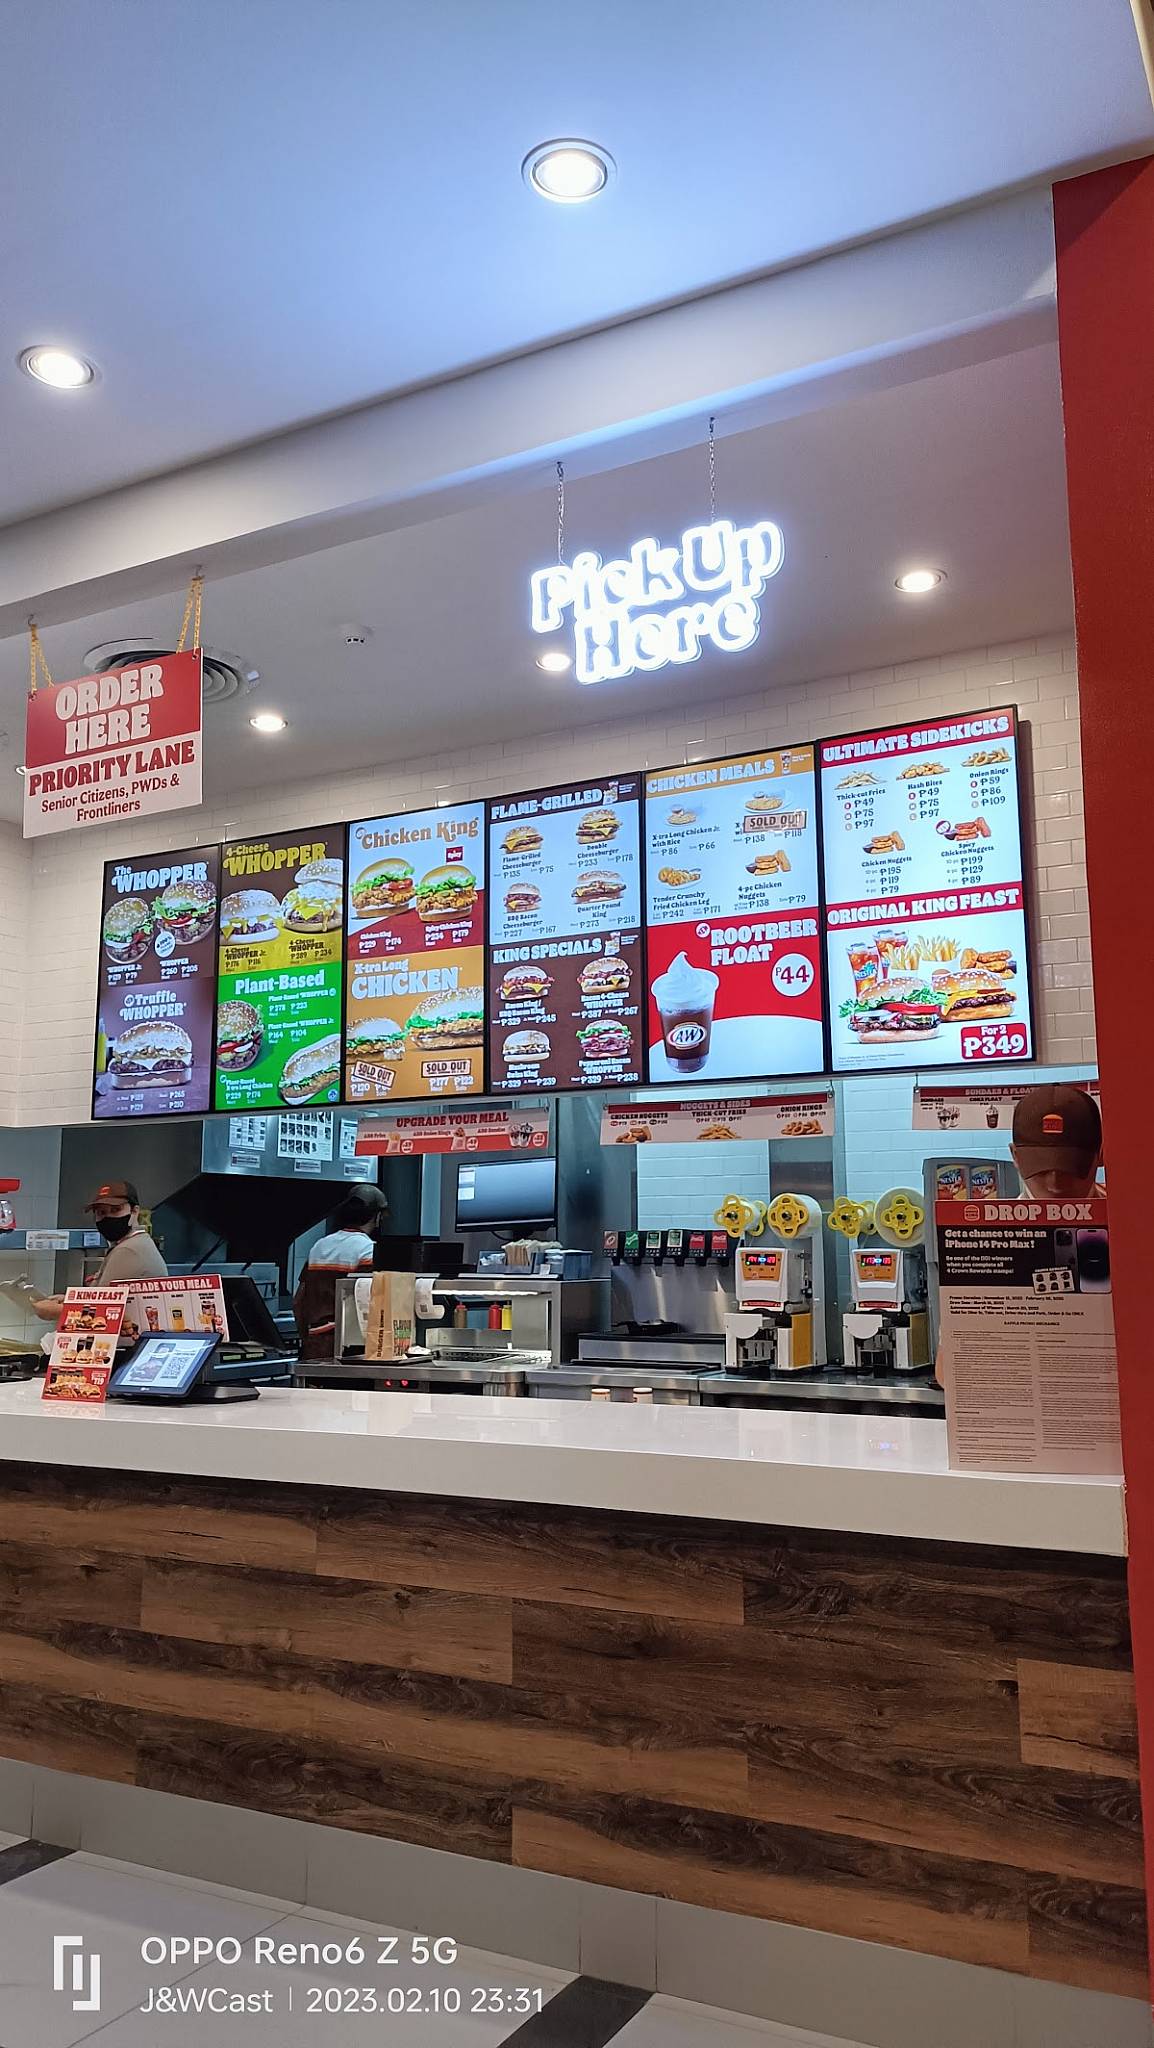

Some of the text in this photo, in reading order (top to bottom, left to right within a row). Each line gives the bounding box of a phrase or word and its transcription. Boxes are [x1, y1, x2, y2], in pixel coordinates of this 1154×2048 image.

[574, 591, 761, 685] Here
[55, 664, 164, 721] ORDER
[65, 703, 151, 755] HERE
[823, 716, 1009, 762] ULTIMATE SIDEKICKS
[29, 740, 195, 796] PRIORITY LANE
[969, 767, 1009, 779] Onion Rings
[646, 768, 718, 794] CHICKEN
[719, 758, 776, 781] MEALS
[907, 779, 943, 790] Hash Bites
[41, 773, 180, 813] Senior Citizens, PWDs &
[868, 788, 886, 797] Fries
[76, 800, 141, 822] Frontliners
[491, 788, 603, 820] FLAME-GRILLED
[749, 813, 802, 828] SOLD OUT
[355, 819, 480, 850] Chicken King
[668, 831, 685, 840] Long
[685, 827, 713, 837] Chicken
[226, 842, 270, 857] 4-Cheese
[652, 838, 681, 847] with Rice
[577, 848, 620, 860] Cheeseburger
[941, 845, 994, 857] Chicken Nuggets
[223, 842, 327, 877] WHOPPER
[502, 859, 542, 871] Cheeseburger
[861, 860, 887, 868] Chicken
[111, 862, 208, 894] WHOPPER
[114, 865, 132, 876] The
[754, 880, 782, 890] Chicken
[653, 891, 705, 904] Tender Crunchy
[738, 891, 766, 900] Nuggets
[653, 898, 710, 911] Fried Chicken Leg
[827, 888, 1020, 925] ORIGINAL KING FEAST
[502, 918, 544, 930] Cheeseburger
[710, 918, 818, 947] ROOTBEER
[289, 941, 324, 952] WHOPPER
[492, 945, 531, 964] KING
[531, 938, 603, 960] SPECIALS
[225, 950, 259, 960] WHOPPER
[711, 943, 773, 967] FLOAT
[354, 959, 409, 975] X-tra Long
[235, 969, 325, 996] Plant-Based
[351, 967, 459, 1000] CHICKEN
[134, 990, 177, 1005] Truffle
[119, 1002, 185, 1021] WHOPPER
[980, 1025, 1007, 1036] For 2
[357, 1063, 392, 1082] SOLD OUT
[426, 1061, 467, 1073] SOLD OUT
[680, 1101, 719, 1111] NUGGETS
[726, 1099, 751, 1108] SIDES
[396, 1111, 509, 1128] UPGRADE YOUR MEAL
[983, 1203, 1094, 1221] DROP BOX
[944, 1229, 961, 1238] Get
[968, 1229, 1003, 1238] chance
[1003, 1230, 1014, 1238] to
[1014, 1229, 1034, 1238] win
[944, 1239, 979, 1248] iPhone
[979, 1240, 990, 1248] 14
[991, 1240, 1009, 1248] Pro
[1009, 1240, 1030, 1248] Max
[161, 1280, 186, 1291] YOUR
[187, 1277, 212, 1289] MEAL
[76, 1291, 98, 1300] KING
[98, 1291, 124, 1300] FEAST
